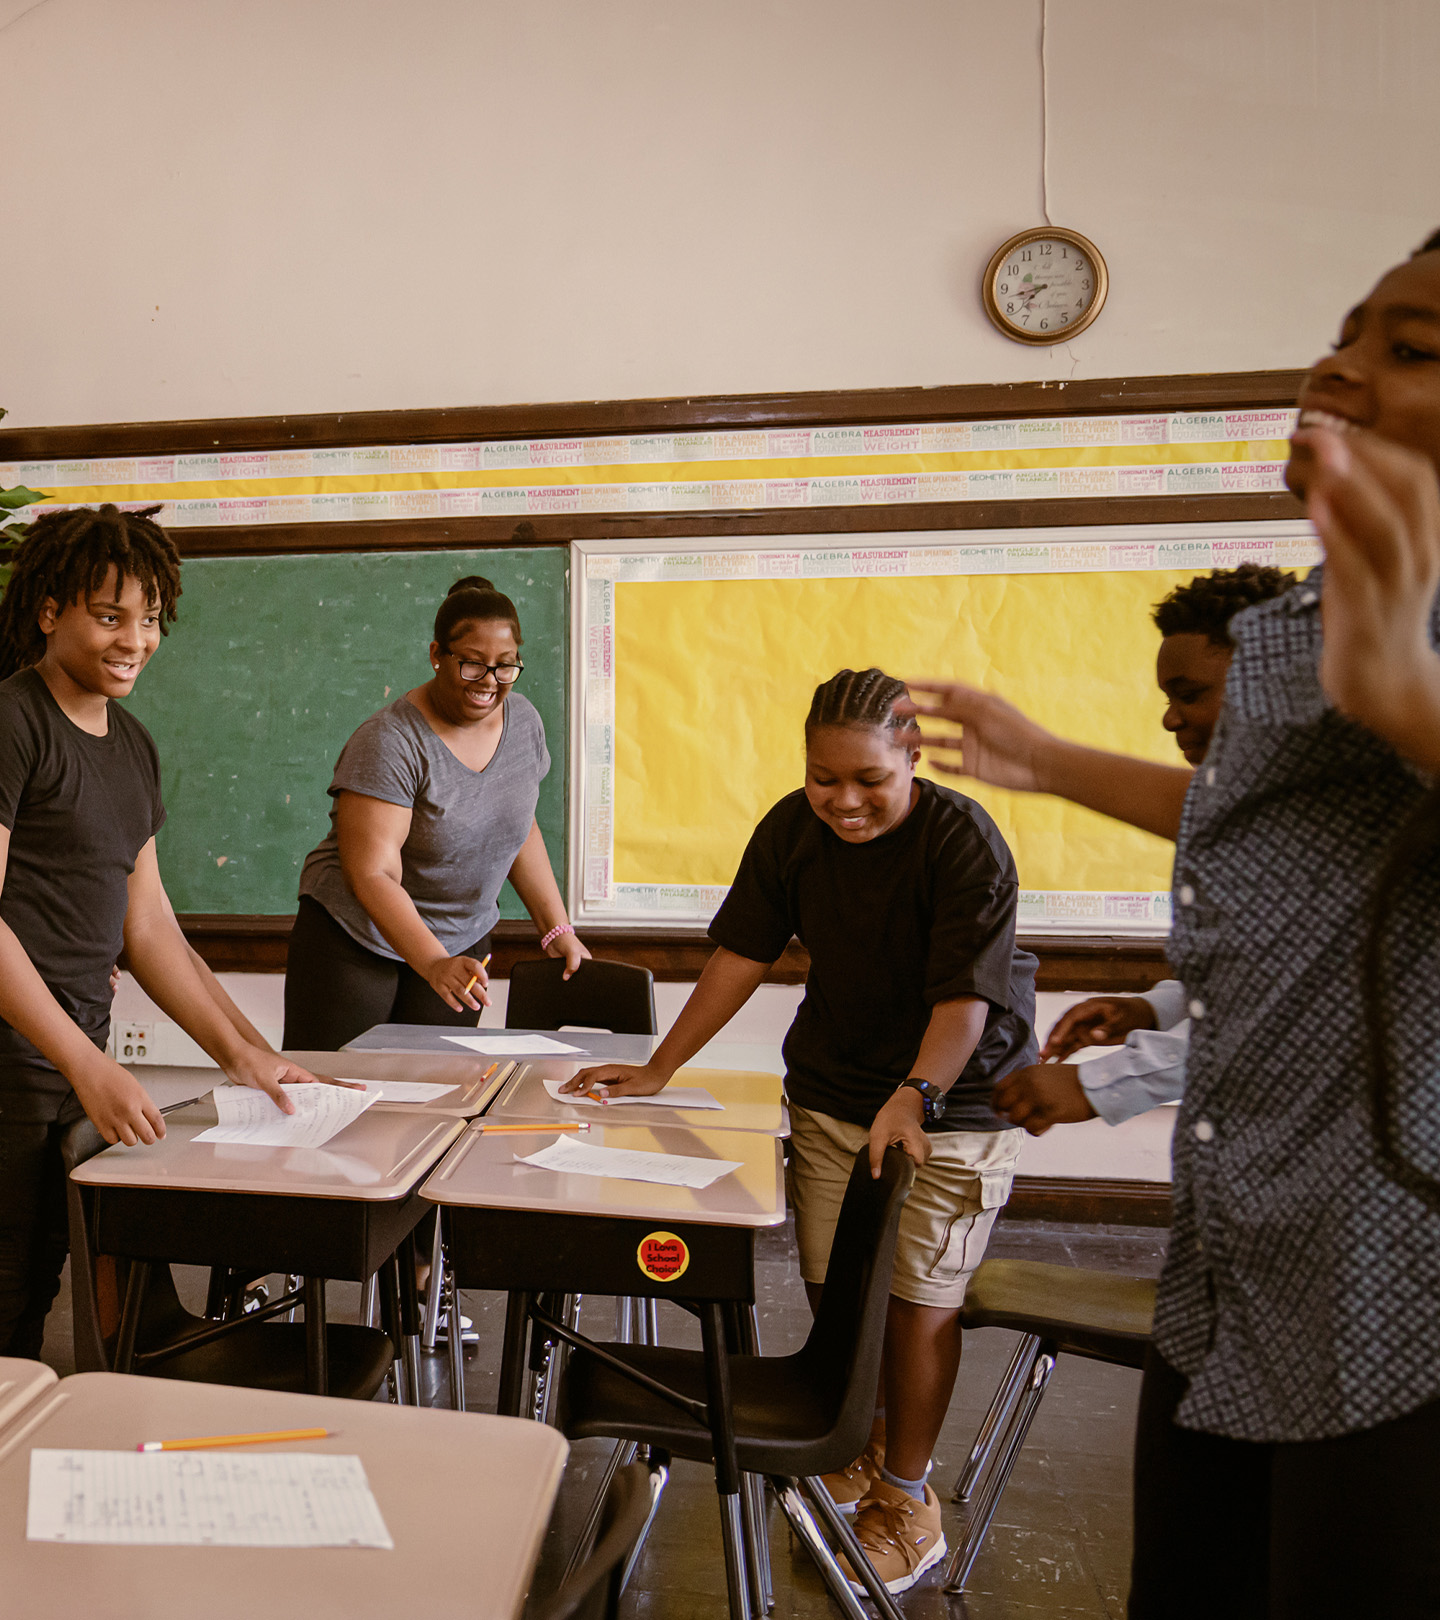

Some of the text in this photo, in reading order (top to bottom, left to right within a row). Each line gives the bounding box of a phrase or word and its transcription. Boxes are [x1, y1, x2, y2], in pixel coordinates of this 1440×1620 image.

[1039, 244, 1052, 256] 12
[1062, 247, 1068, 259] 1
[1021, 250, 1032, 262] 11
[1007, 264, 1019, 276] 10
[1075, 260, 1084, 271] 2
[1000, 283, 1009, 295] 9
[1081, 279, 1090, 290] 3
[1006, 302, 1015, 313] 8
[1075, 297, 1084, 309] 4
[1021, 314, 1030, 326] 7
[1060, 312, 1069, 323] 5
[1040, 318, 1048, 330] 6
[1172, 416, 1224, 425] ALGEBRA
[1225, 413, 1288, 423] MEASUREMENT
[864, 428, 920, 437] MEASUREMENT
[972, 424, 1016, 432] GEOMETRY
[1226, 427, 1286, 437] WEIGHT
[814, 431, 861, 439] ALGEBRA
[530, 441, 582, 451] MEASUREMENT
[630, 438, 670, 446] GEOMETRY
[864, 441, 919, 451] WEIGHT
[484, 444, 528, 453] ALGEBRA
[178, 457, 219, 465] ALGEBRA
[220, 455, 268, 464] MEASUREMENT
[530, 454, 582, 464] WEIGHT
[220, 466, 267, 476] WEIGHT
[1168, 467, 1220, 476] ALGEBRA
[1221, 464, 1283, 474] MEASUREMENT
[860, 477, 917, 487] MEASUREMENT
[969, 474, 1013, 482] GEOMETRY
[1221, 478, 1282, 488] WEIGHT
[811, 480, 859, 488] ALGEBRA
[482, 490, 526, 498] ALGEBRA
[527, 488, 580, 497] MEASUREMENT
[861, 490, 916, 500] WEIGHT
[177, 502, 218, 510] ALGEBRA
[219, 500, 267, 509] MEASUREMENT
[528, 501, 579, 511] WEIGHT
[219, 512, 266, 522] WEIGHT
[1158, 543, 1210, 551] ALGEBRA
[1212, 541, 1274, 550] MEASUREMENT
[803, 552, 850, 561] ALGEBRA
[852, 551, 908, 559] MEASUREMENT
[960, 548, 1004, 556] GEOMETRY
[1212, 554, 1271, 565] WEIGHT
[852, 563, 906, 573] WEIGHT
[590, 625, 598, 677] WEIGHT
[648, 1243, 678, 1252] I Love
[647, 1253, 680, 1262] School
[646, 1264, 681, 1273] Choice!
